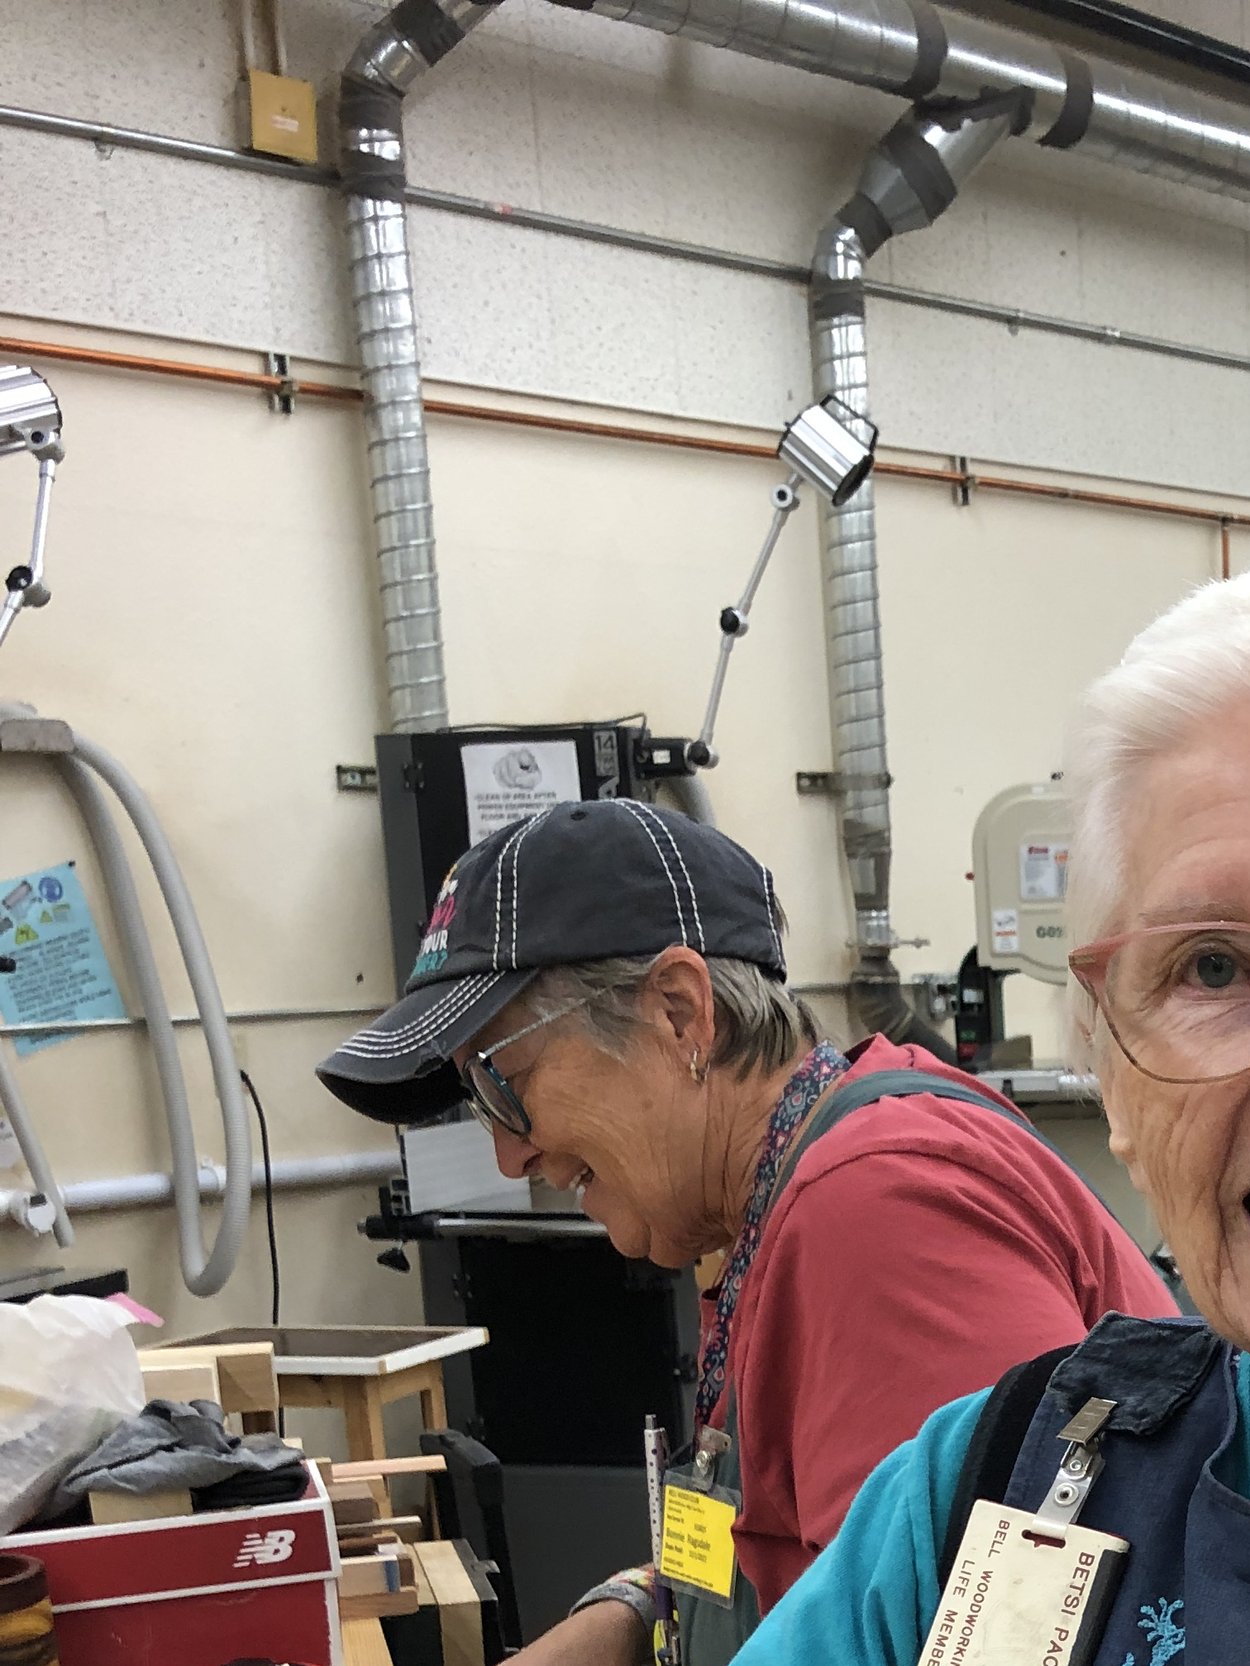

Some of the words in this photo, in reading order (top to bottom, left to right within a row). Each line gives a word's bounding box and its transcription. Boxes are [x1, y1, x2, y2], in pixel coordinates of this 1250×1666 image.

[988, 1519, 1010, 1558] BELL
[953, 1559, 975, 1598] LIFE
[1061, 1552, 1095, 1616] BETSI
